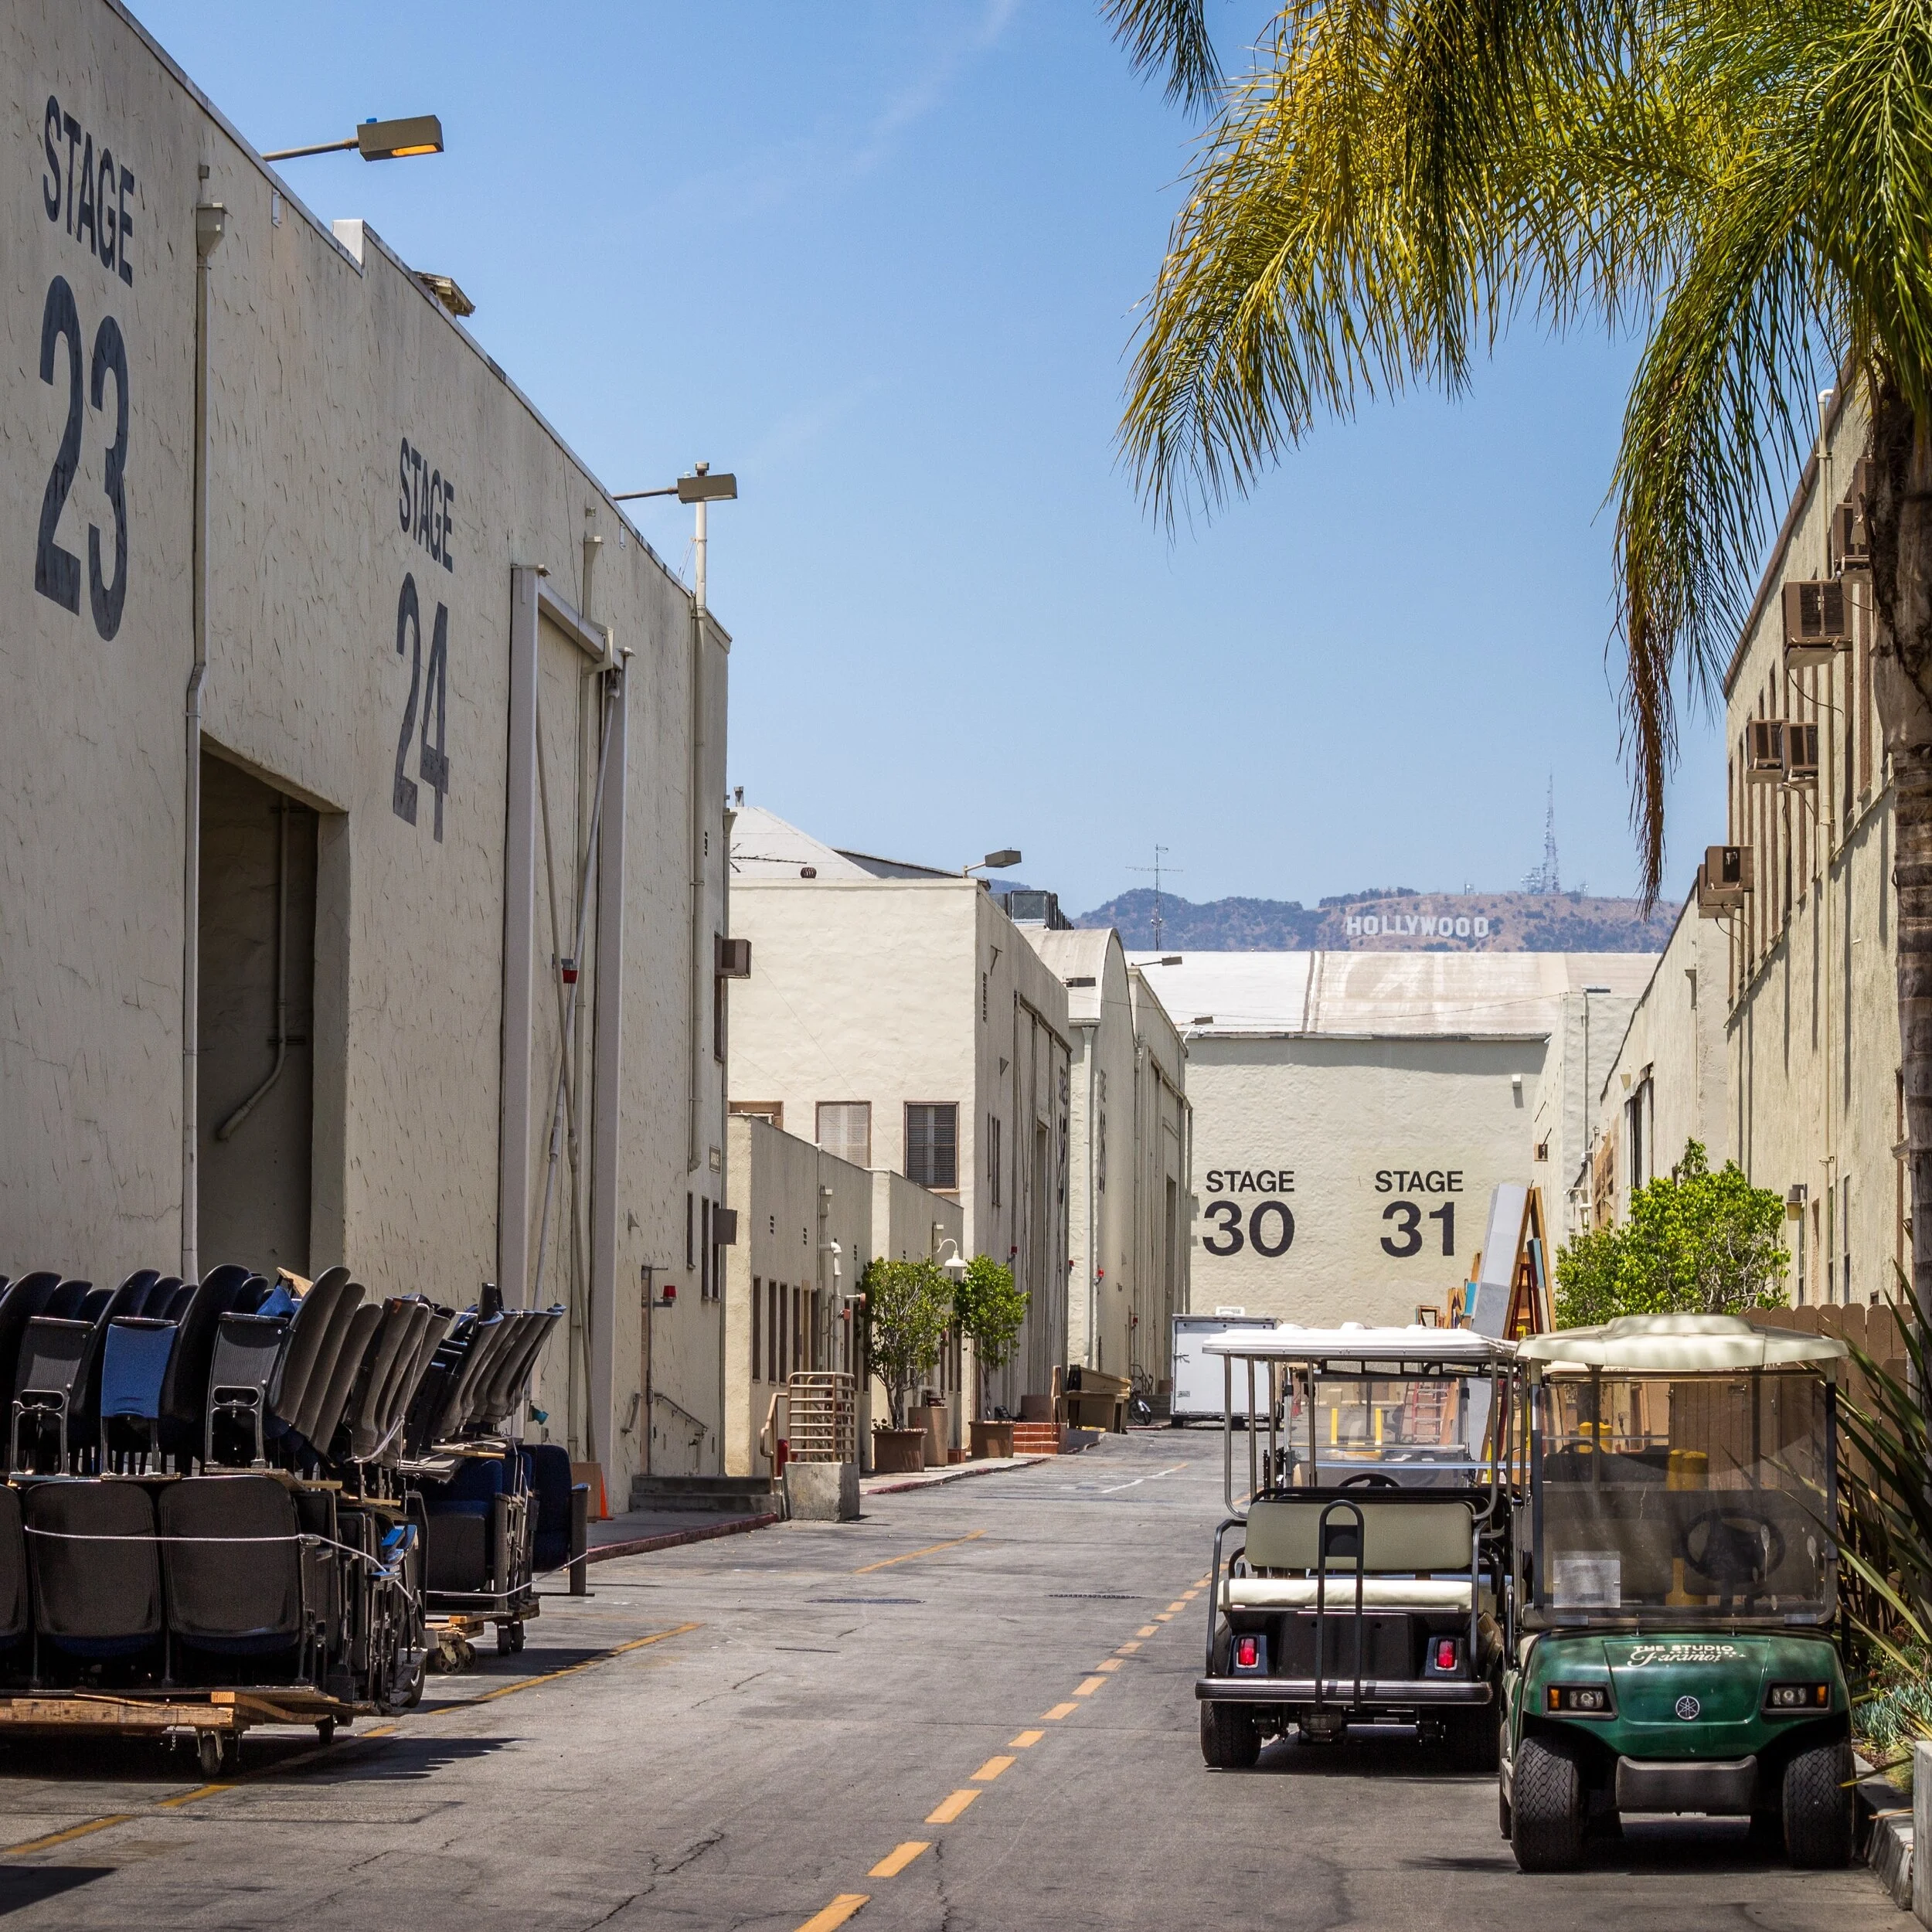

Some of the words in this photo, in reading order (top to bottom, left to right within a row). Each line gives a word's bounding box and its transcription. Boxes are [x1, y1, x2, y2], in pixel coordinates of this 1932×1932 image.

[43, 94, 134, 287] STAGE
[34, 274, 129, 641] 23
[399, 437, 454, 573] STAGE
[393, 572, 450, 844] 24
[1345, 914, 1490, 938] HOLLYWOOD
[1206, 1169, 1295, 1193] STAGE
[1375, 1169, 1464, 1193] STAGE
[1202, 1200, 1295, 1258] 30
[1380, 1200, 1455, 1258] 31
